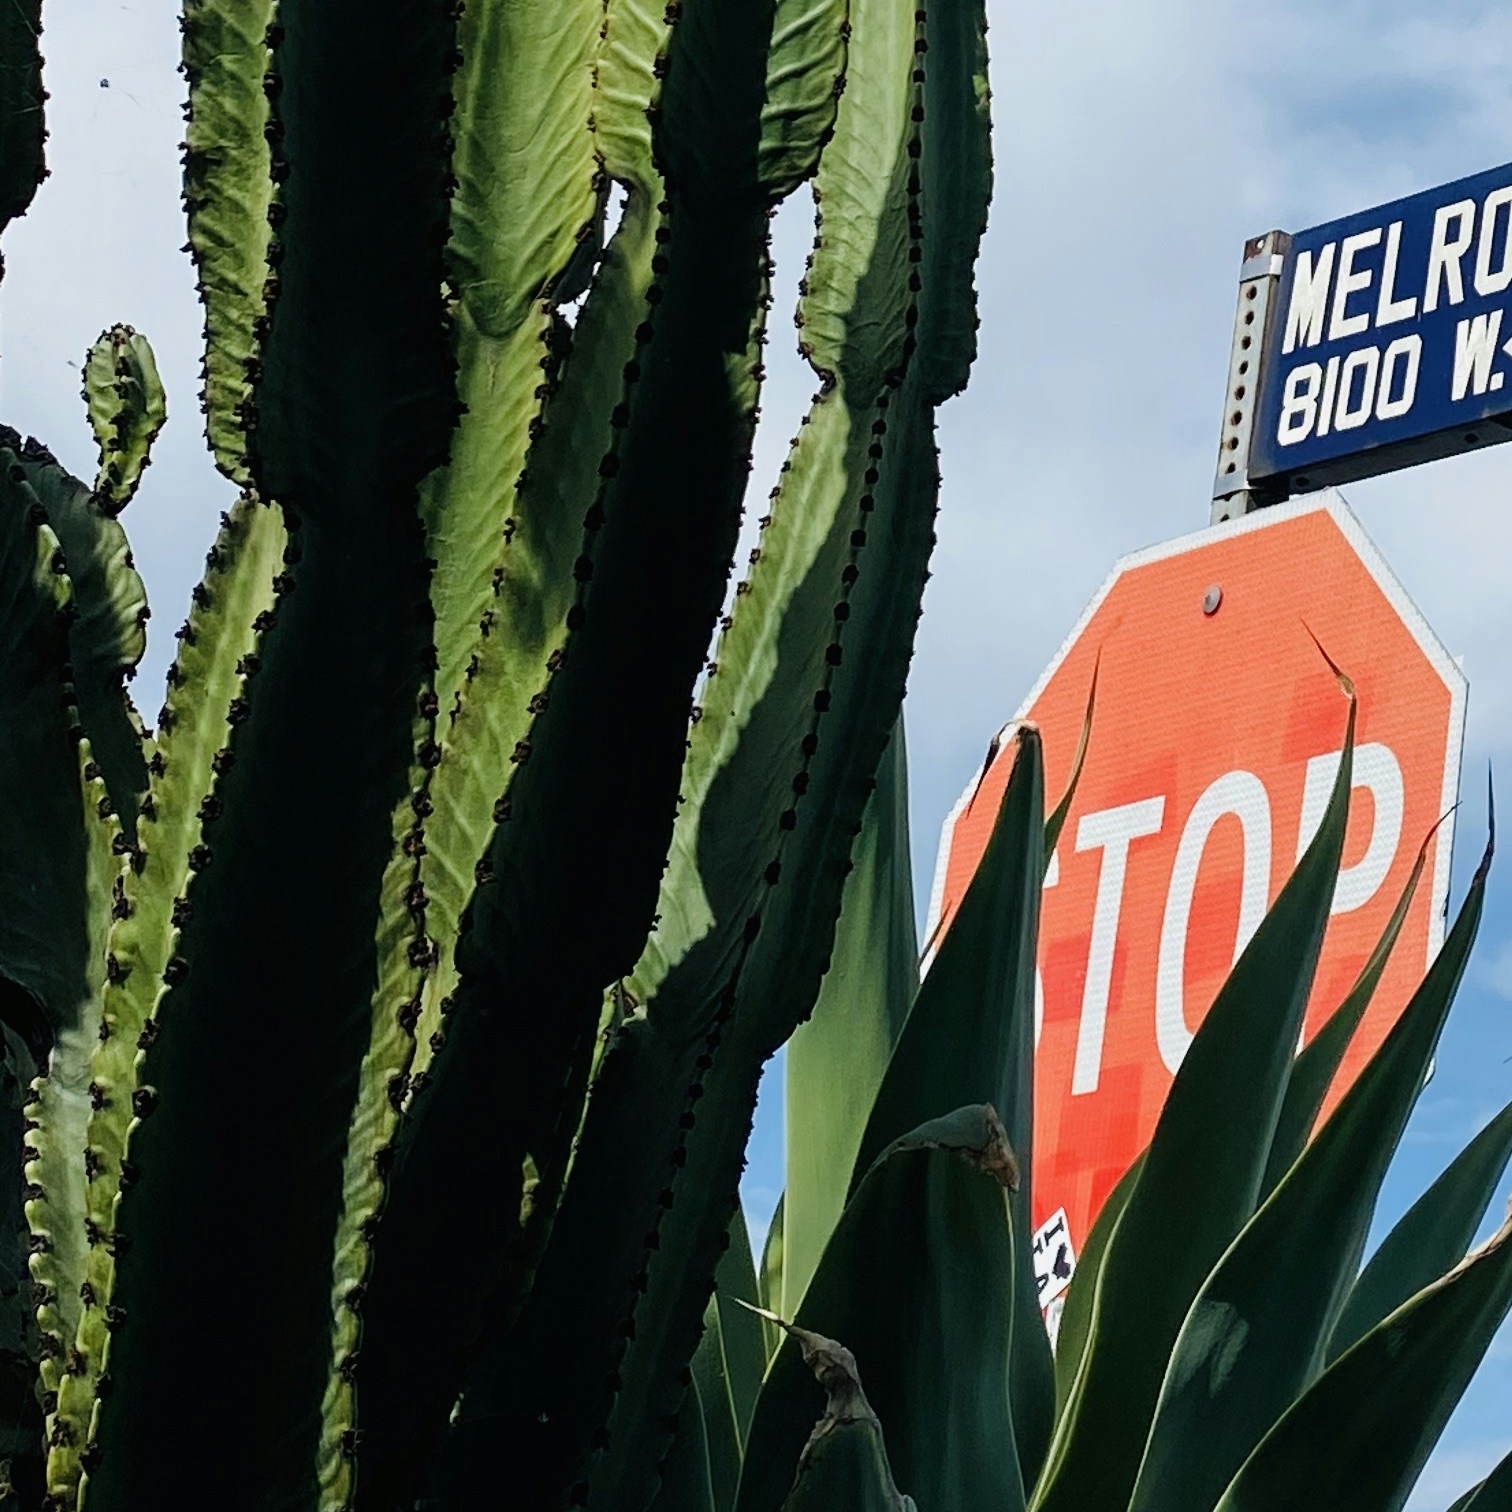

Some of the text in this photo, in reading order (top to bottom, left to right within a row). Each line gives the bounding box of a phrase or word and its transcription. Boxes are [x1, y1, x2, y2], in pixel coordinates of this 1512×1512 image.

[1277, 309, 1505, 447] 8100 W.
[1034, 742, 1403, 1096] TOP
